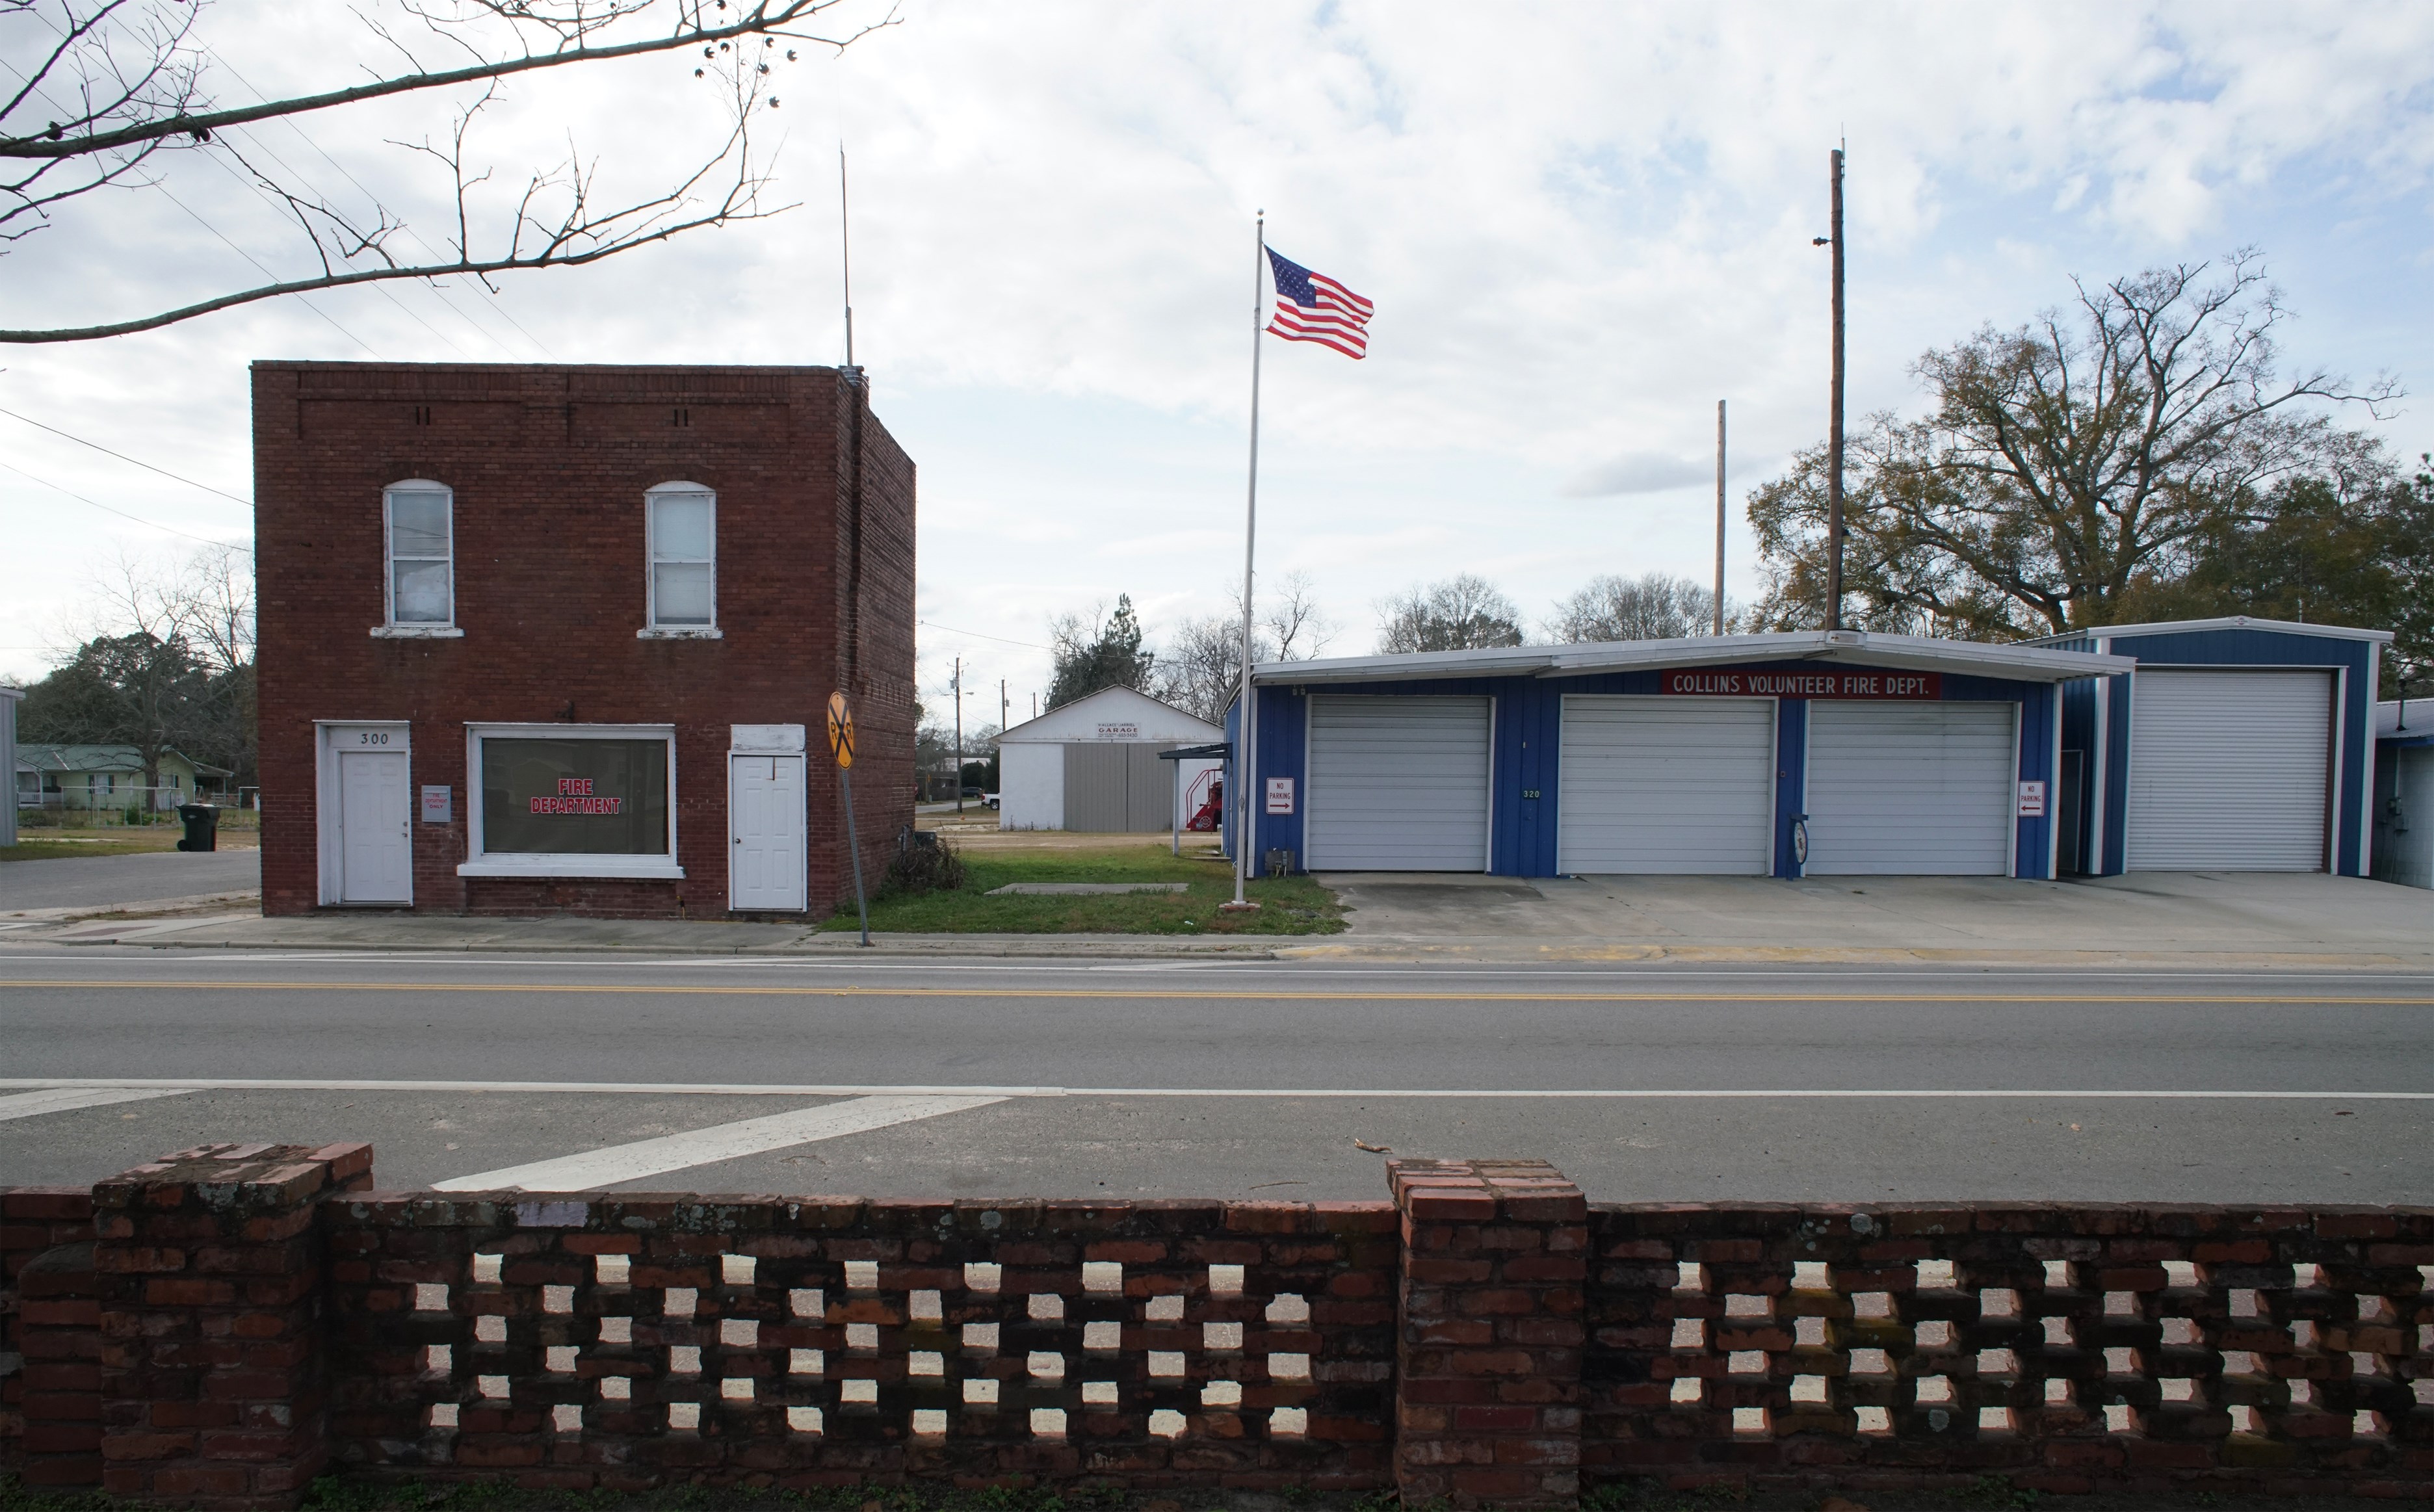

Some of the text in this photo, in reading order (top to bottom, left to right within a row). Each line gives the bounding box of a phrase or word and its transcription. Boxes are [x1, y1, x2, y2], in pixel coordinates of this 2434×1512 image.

[1673, 675, 1930, 695] COLLINS VOLUNTEER FIRE DEPT.
[361, 733, 388, 744] 300
[830, 722, 853, 740] R R
[558, 779, 593, 795] FIRE
[531, 797, 621, 814] DEPARTMENT
